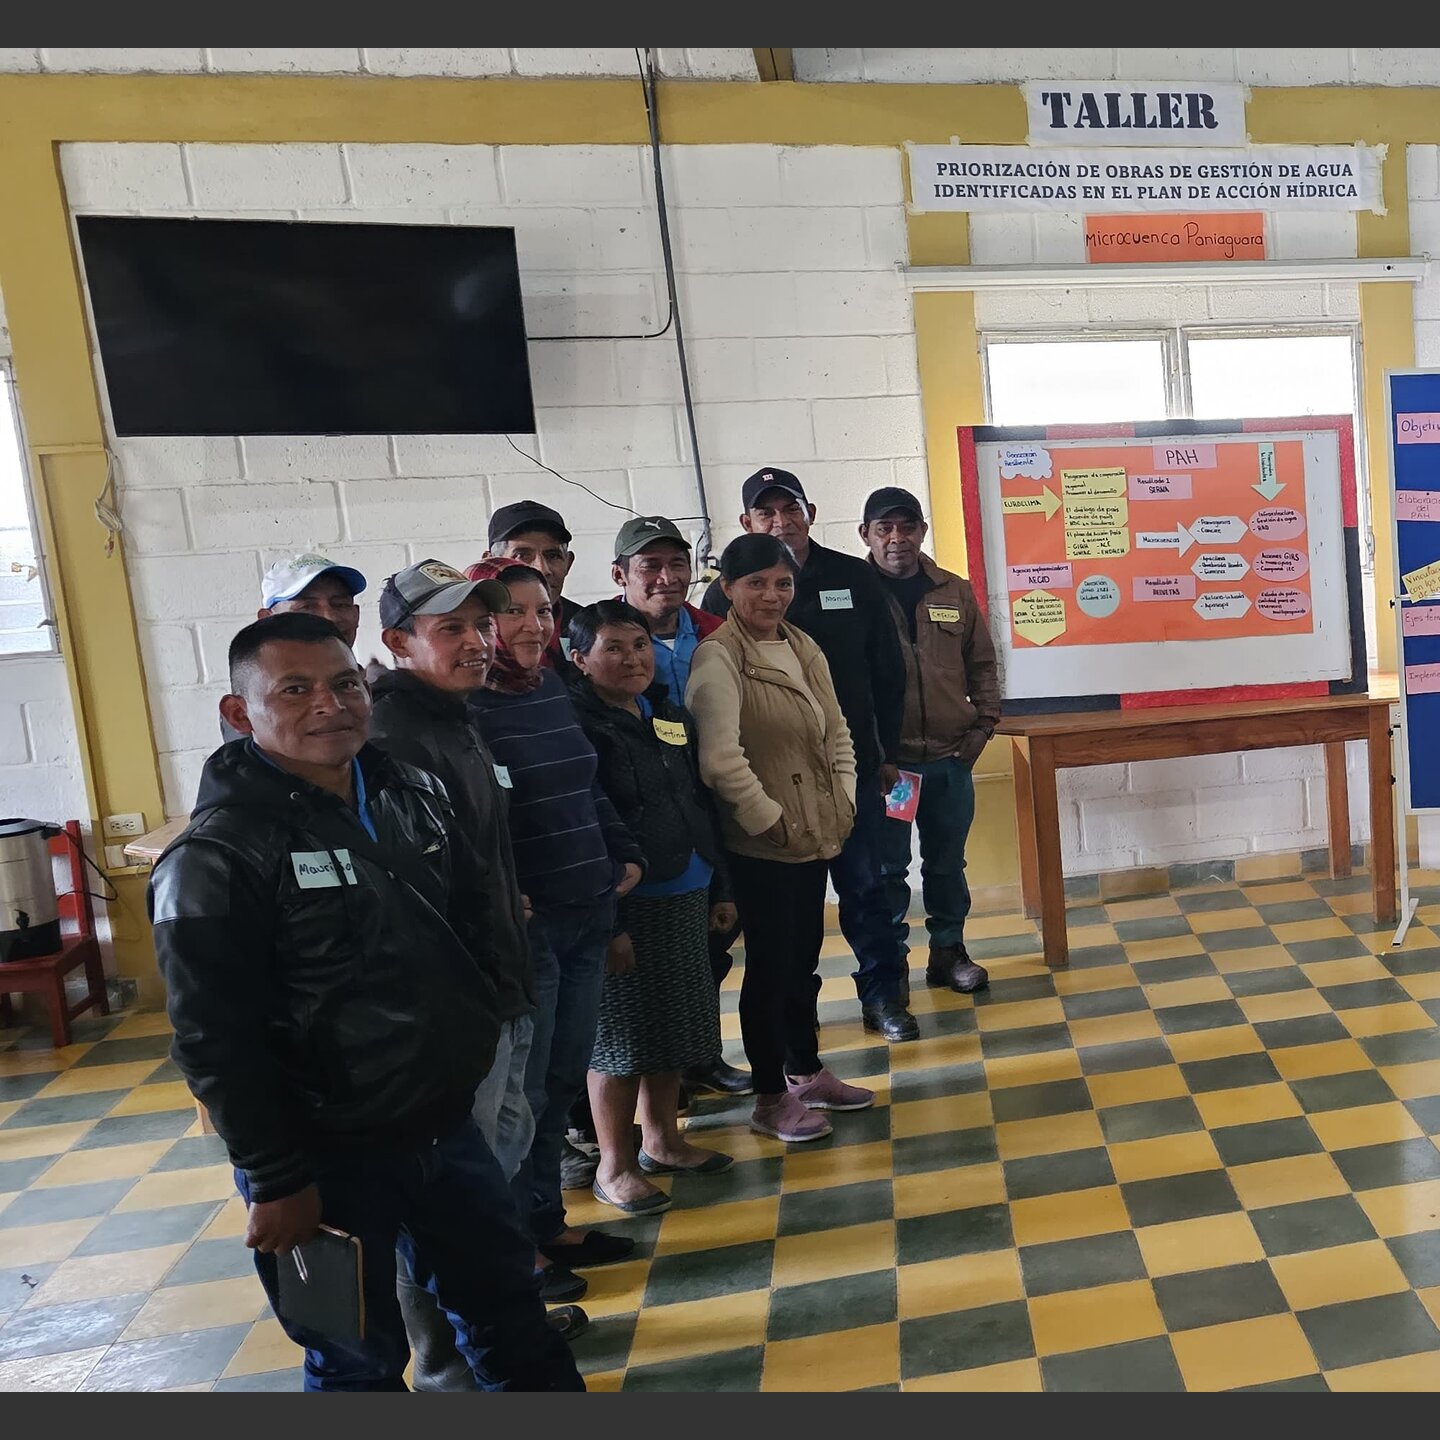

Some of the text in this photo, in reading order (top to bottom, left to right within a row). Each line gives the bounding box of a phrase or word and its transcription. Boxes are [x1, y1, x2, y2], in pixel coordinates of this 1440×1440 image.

[1042, 92, 1218, 130] TALLER
[936, 160, 1353, 179] PRIORIZACIÓN DE OBRAS DE GESTIÓN DE AGUA
[934, 180, 1358, 200] IDENTIFICADAS EN EL PLAN DE ACCIÓN HÍDRICA
[1086, 222, 1263, 258] Microcuenca Paniaguara
[1166, 449, 1199, 466] PAH
